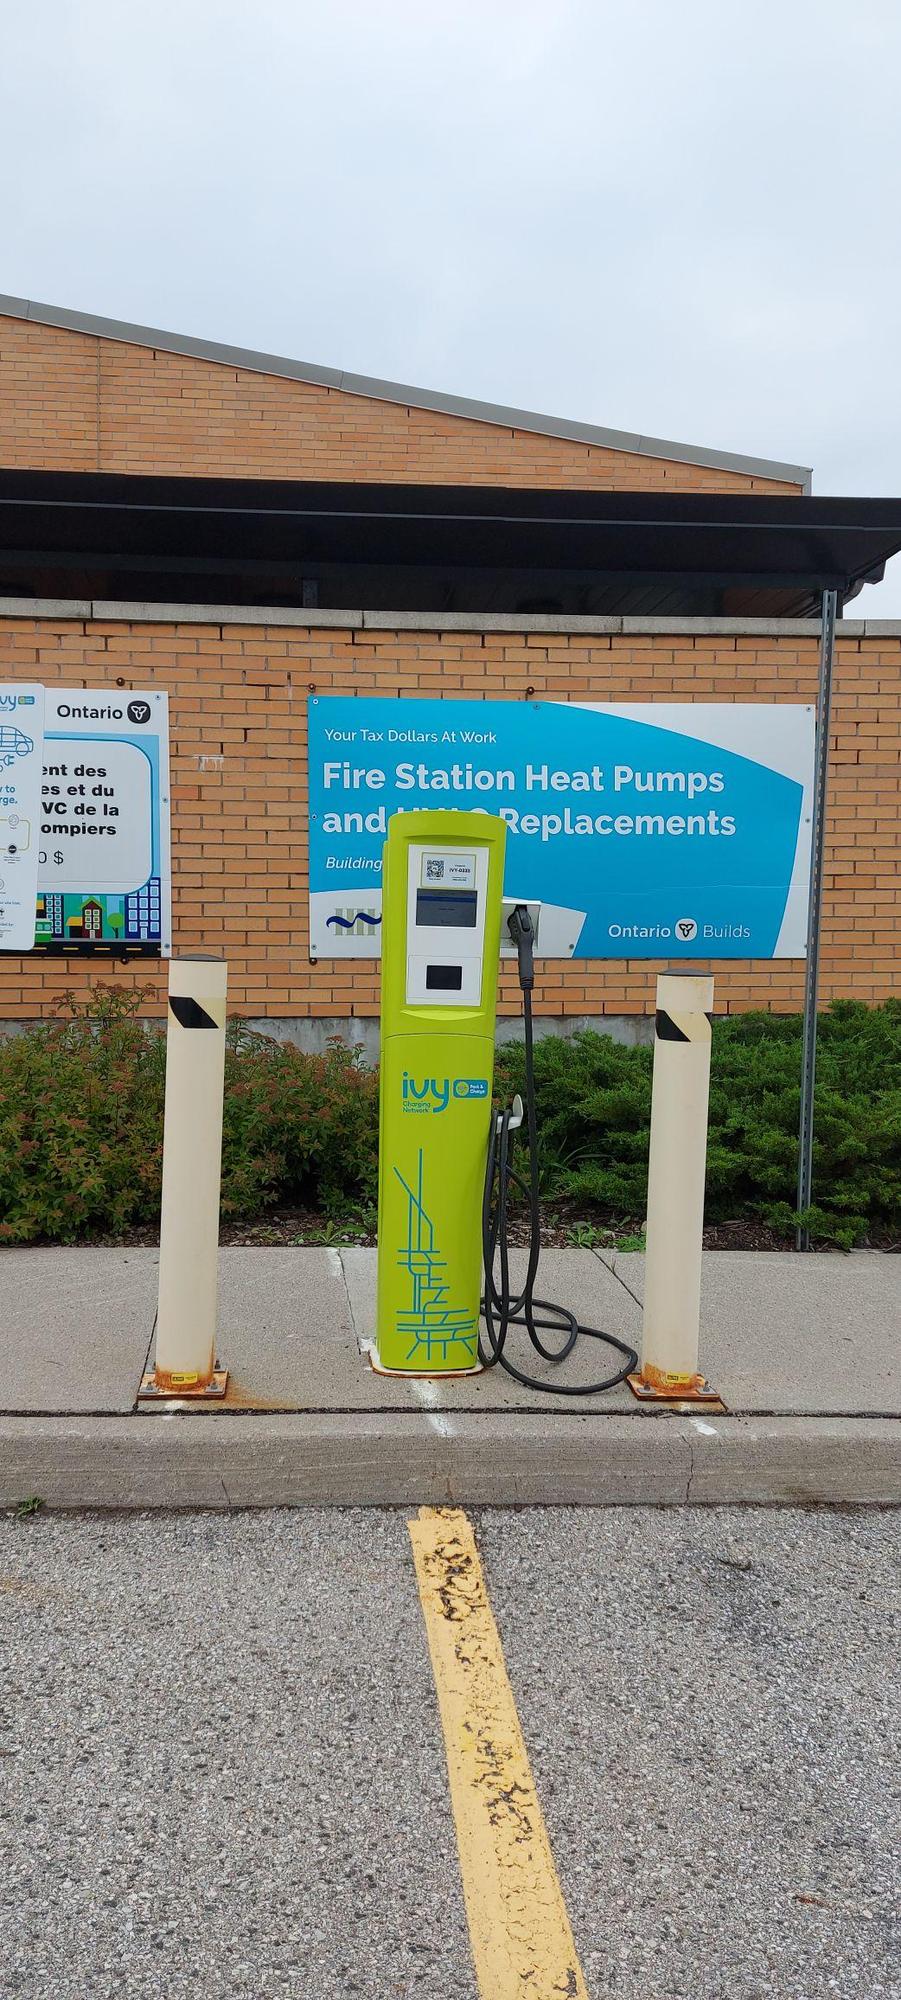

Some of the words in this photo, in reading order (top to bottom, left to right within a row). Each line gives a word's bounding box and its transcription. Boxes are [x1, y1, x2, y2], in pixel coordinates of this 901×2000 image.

[57, 704, 123, 720] Ontario
[325, 728, 358, 742] Your
[360, 729, 384, 742] Tax
[388, 729, 438, 743] Dollars
[441, 730, 456, 743] At
[460, 730, 497, 744] Work
[74, 764, 107, 778] des
[323, 761, 386, 789] Fire
[395, 763, 515, 791] Station
[526, 764, 604, 791] Heat
[614, 765, 725, 799] Pumps
[67, 783, 85, 797] et
[91, 783, 114, 798] du
[41, 802, 67, 815] VC
[74, 803, 97, 816] de
[103, 803, 119, 817] la
[40, 821, 117, 837] ompiers
[322, 806, 386, 833] and
[500, 807, 736, 842] Replacements
[53, 849, 64, 866] $
[326, 856, 383, 872] Building
[608, 924, 671, 938] Ontario
[703, 924, 751, 939] Builds
[402, 1071, 450, 1114] ivy
[402, 1100, 431, 1108] Charging
